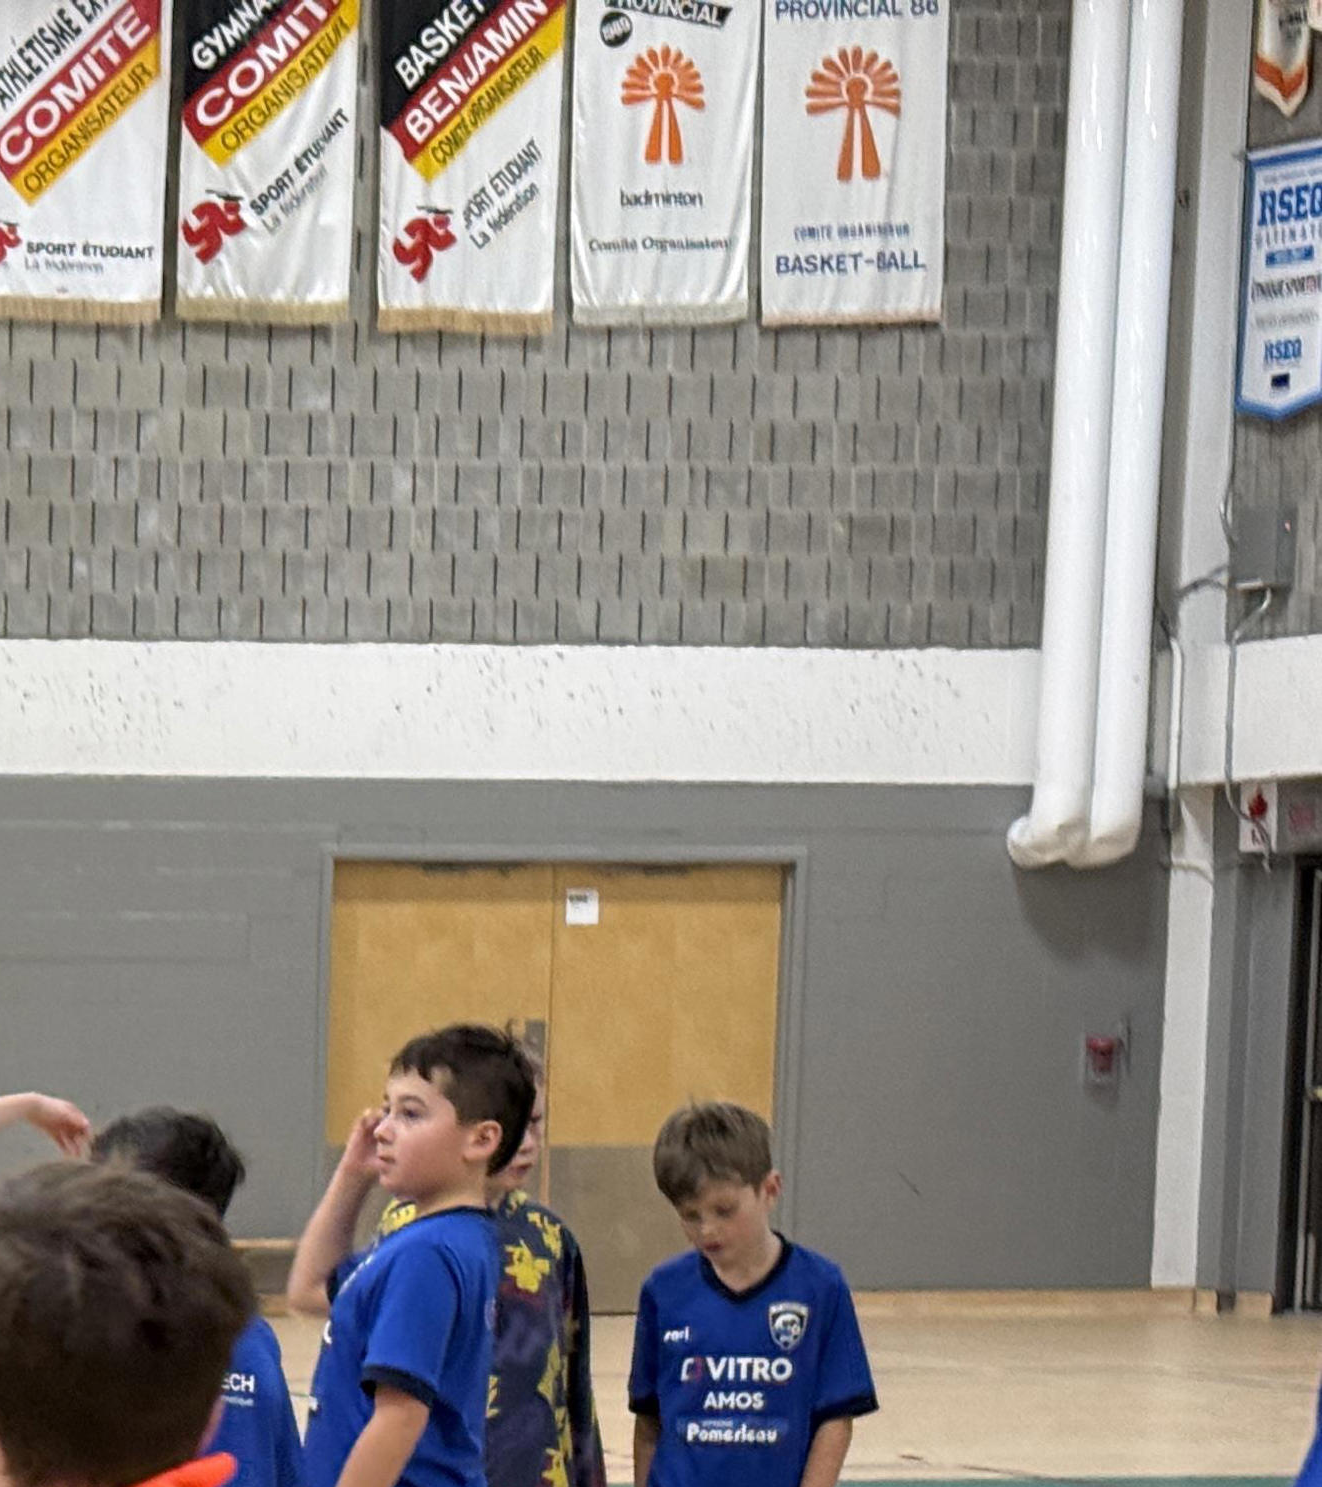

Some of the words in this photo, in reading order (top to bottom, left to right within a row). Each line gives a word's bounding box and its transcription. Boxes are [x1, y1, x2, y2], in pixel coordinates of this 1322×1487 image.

[606, 0, 721, 26] OVINCIAL
[775, 0, 902, 22] PROVINCIAL
[197, 0, 338, 127] COMIT
[405, 0, 549, 145] BENJAMIN
[23, 62, 153, 194] ORGANISATEUR
[249, 168, 295, 216] SPORT
[619, 186, 703, 207] badminton
[26, 241, 77, 255] SPORT
[83, 240, 155, 260] ÉTUDIANT
[775, 249, 927, 277] BASKET-BALL
[706, 1356, 793, 1382] VITRO
[703, 1391, 764, 1410] AMOS
